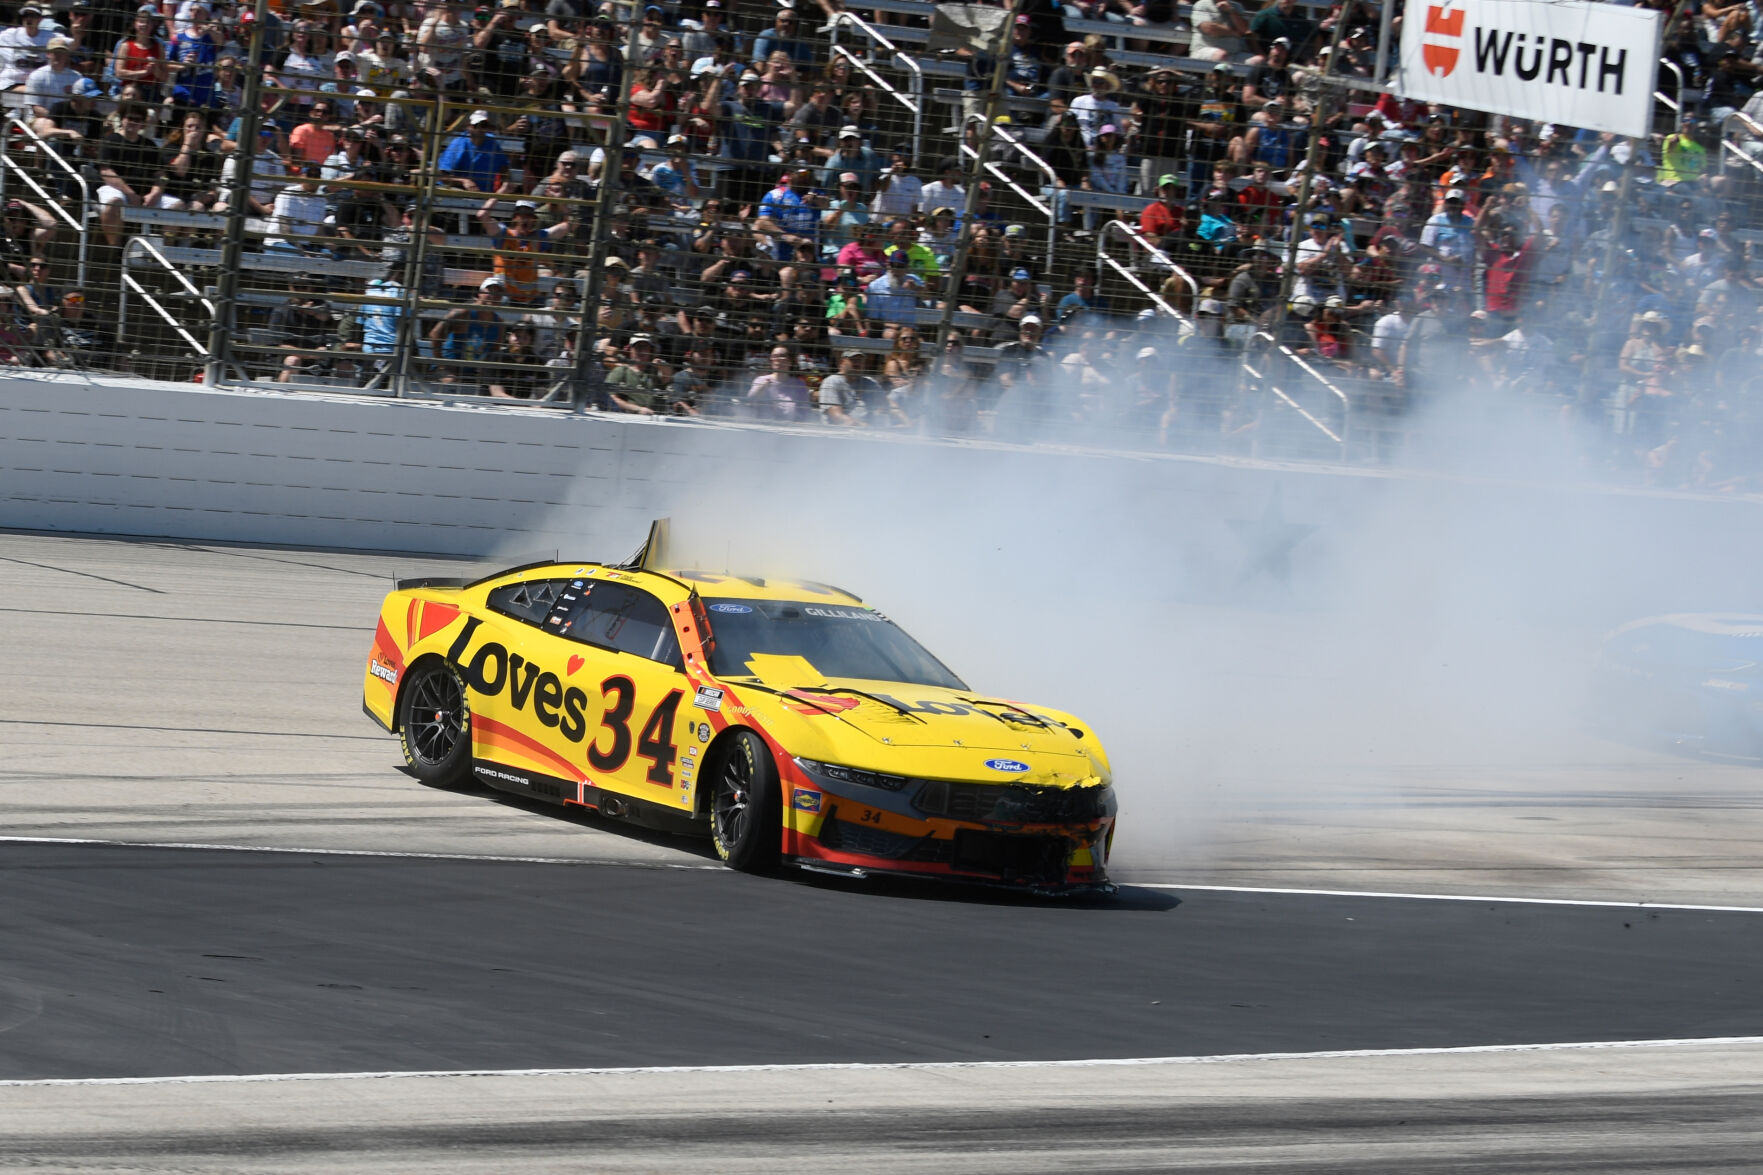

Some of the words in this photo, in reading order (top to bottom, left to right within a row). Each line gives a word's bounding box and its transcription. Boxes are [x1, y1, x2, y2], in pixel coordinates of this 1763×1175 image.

[1475, 26, 1627, 95] WÜRTH
[804, 607, 881, 622] GILLILAND
[586, 674, 686, 789] 34
[474, 766, 497, 777] FORD
[498, 772, 529, 785] RACING
[860, 809, 882, 824] 34
